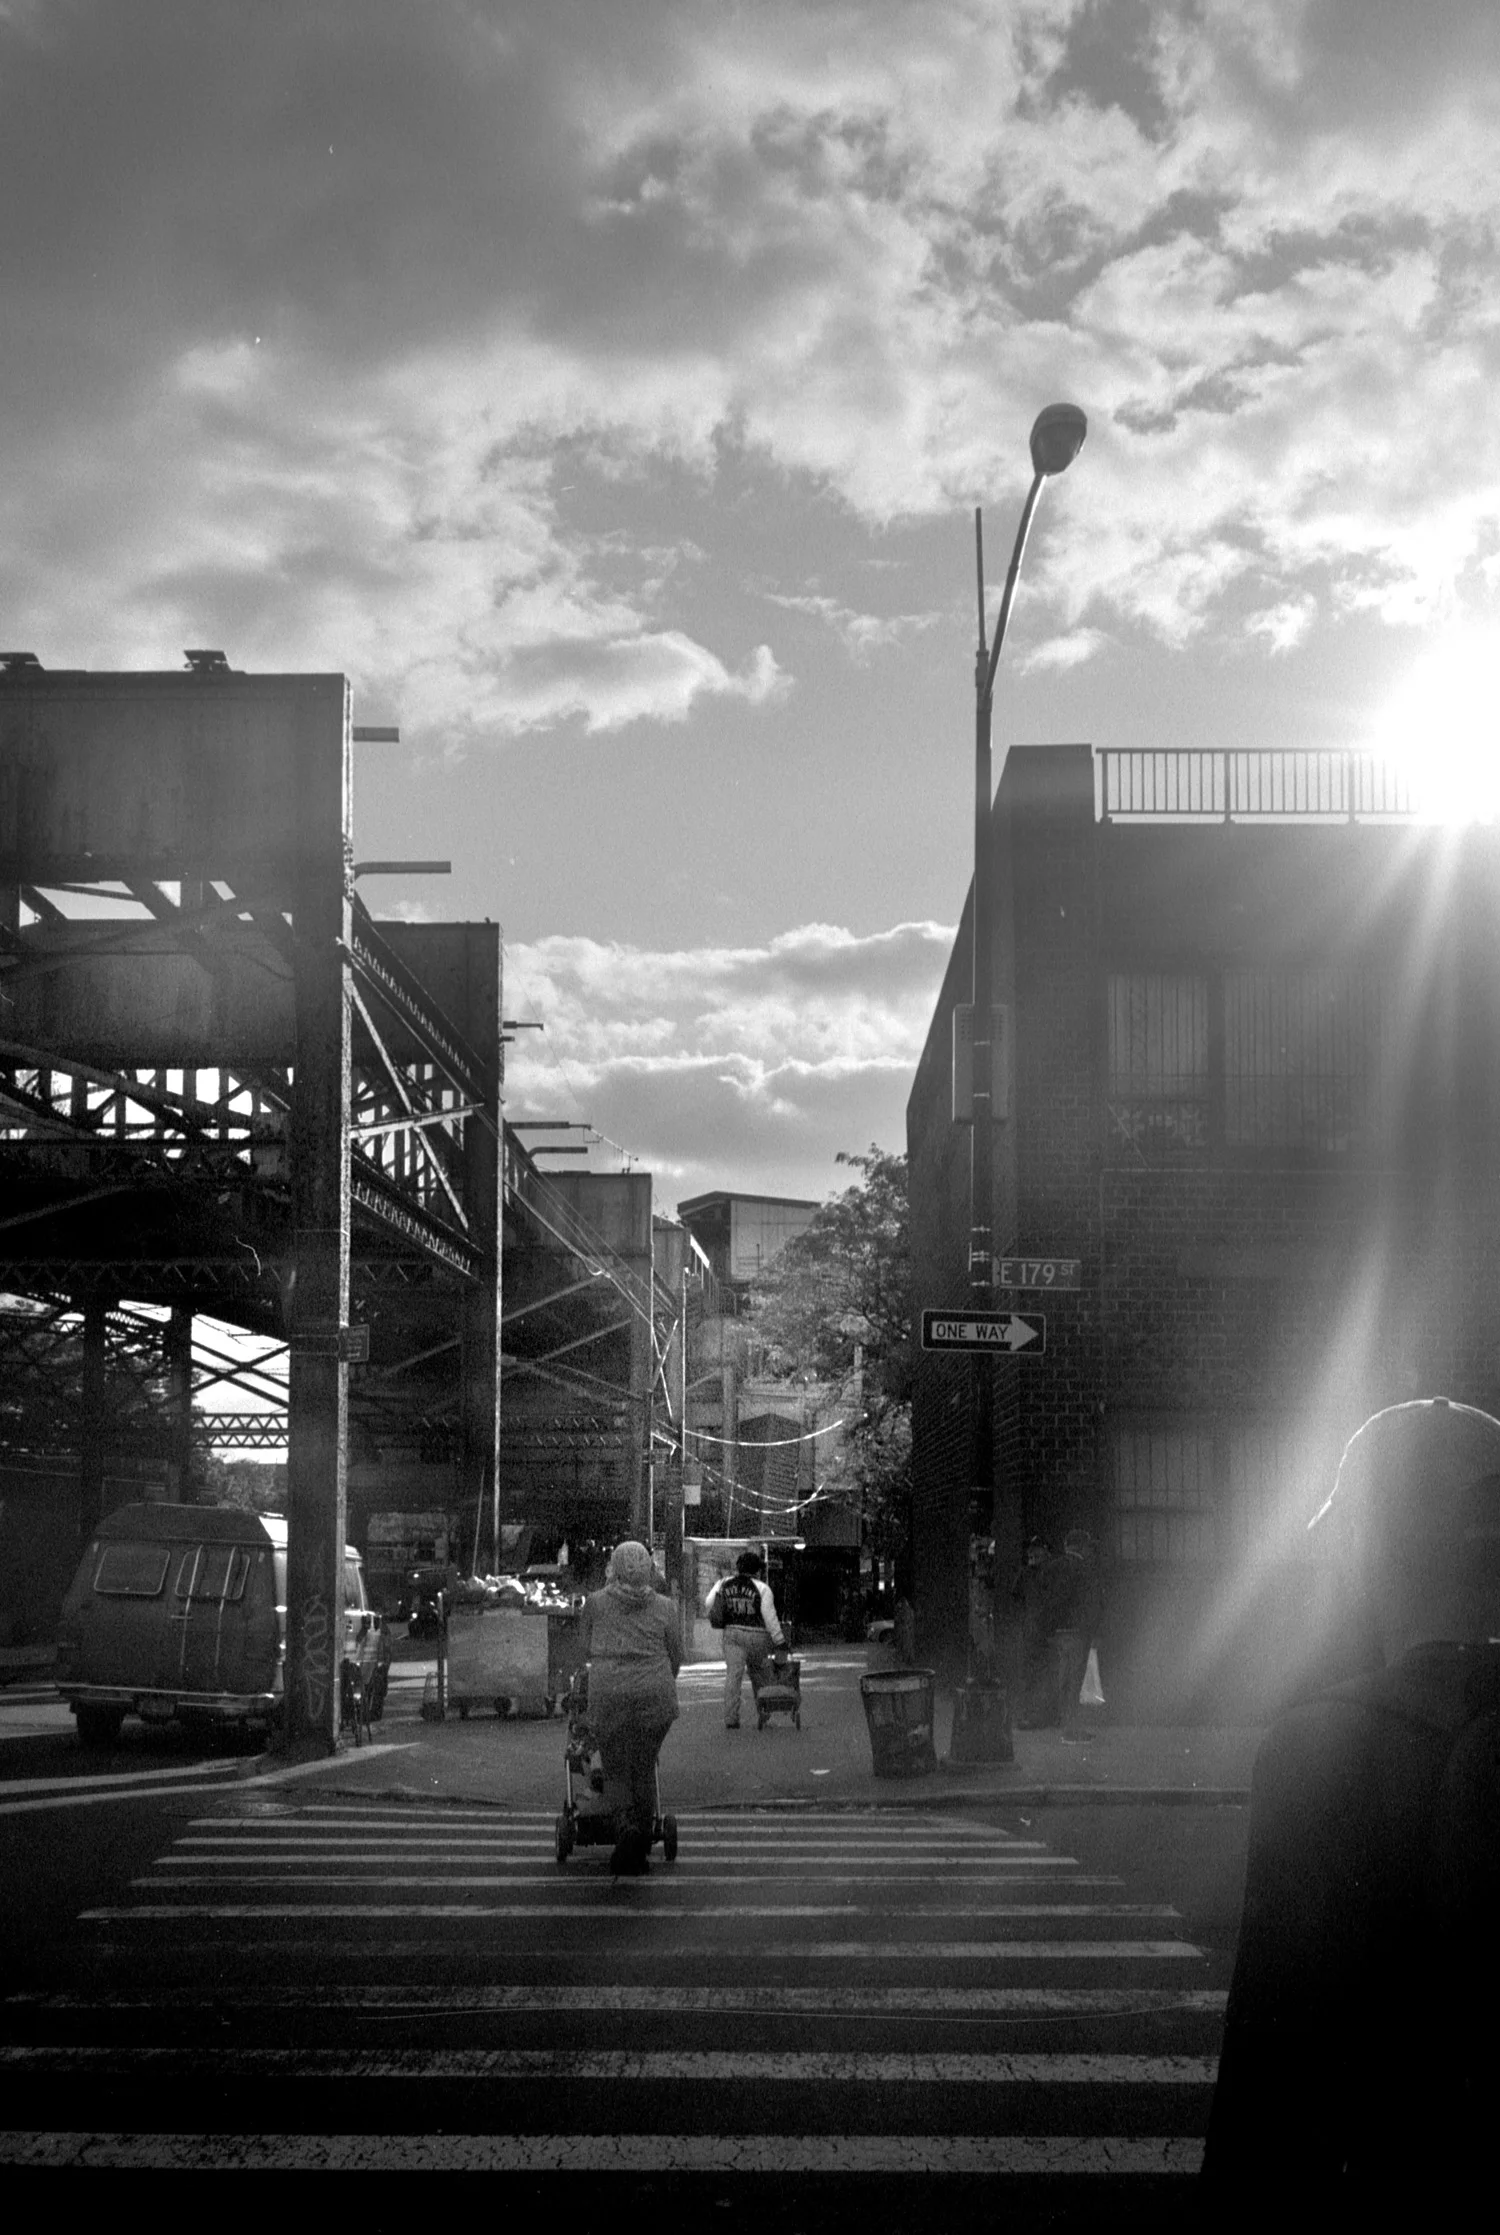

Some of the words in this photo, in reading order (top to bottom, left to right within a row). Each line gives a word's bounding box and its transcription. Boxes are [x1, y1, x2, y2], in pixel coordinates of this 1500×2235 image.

[1001, 1262, 1013, 1284] E
[1021, 1263, 1055, 1285] 179
[1060, 1263, 1075, 1276] ST
[936, 1323, 967, 1339] ONE
[976, 1324, 1009, 1340] WAY
